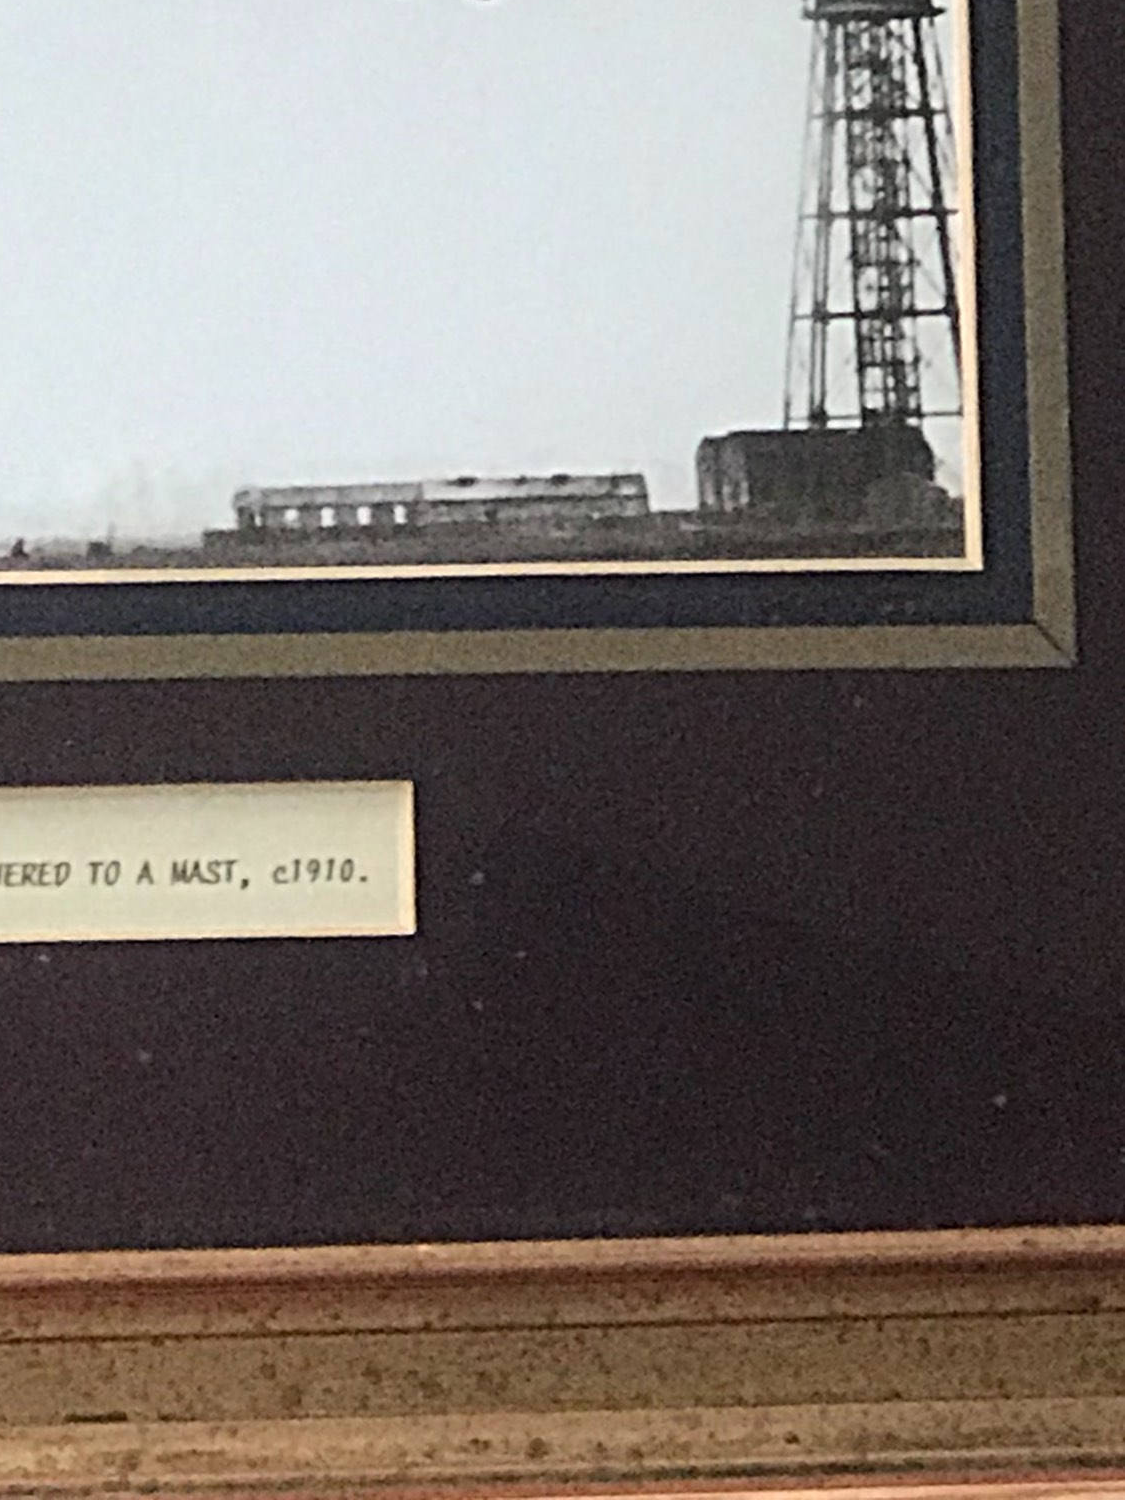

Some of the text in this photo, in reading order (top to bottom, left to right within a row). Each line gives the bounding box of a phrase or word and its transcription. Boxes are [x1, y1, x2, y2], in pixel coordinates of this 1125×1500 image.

[88, 860, 122, 887] TO
[135, 860, 156, 886] A
[169, 858, 251, 891] MAST,
[271, 857, 370, 885] c1910.
